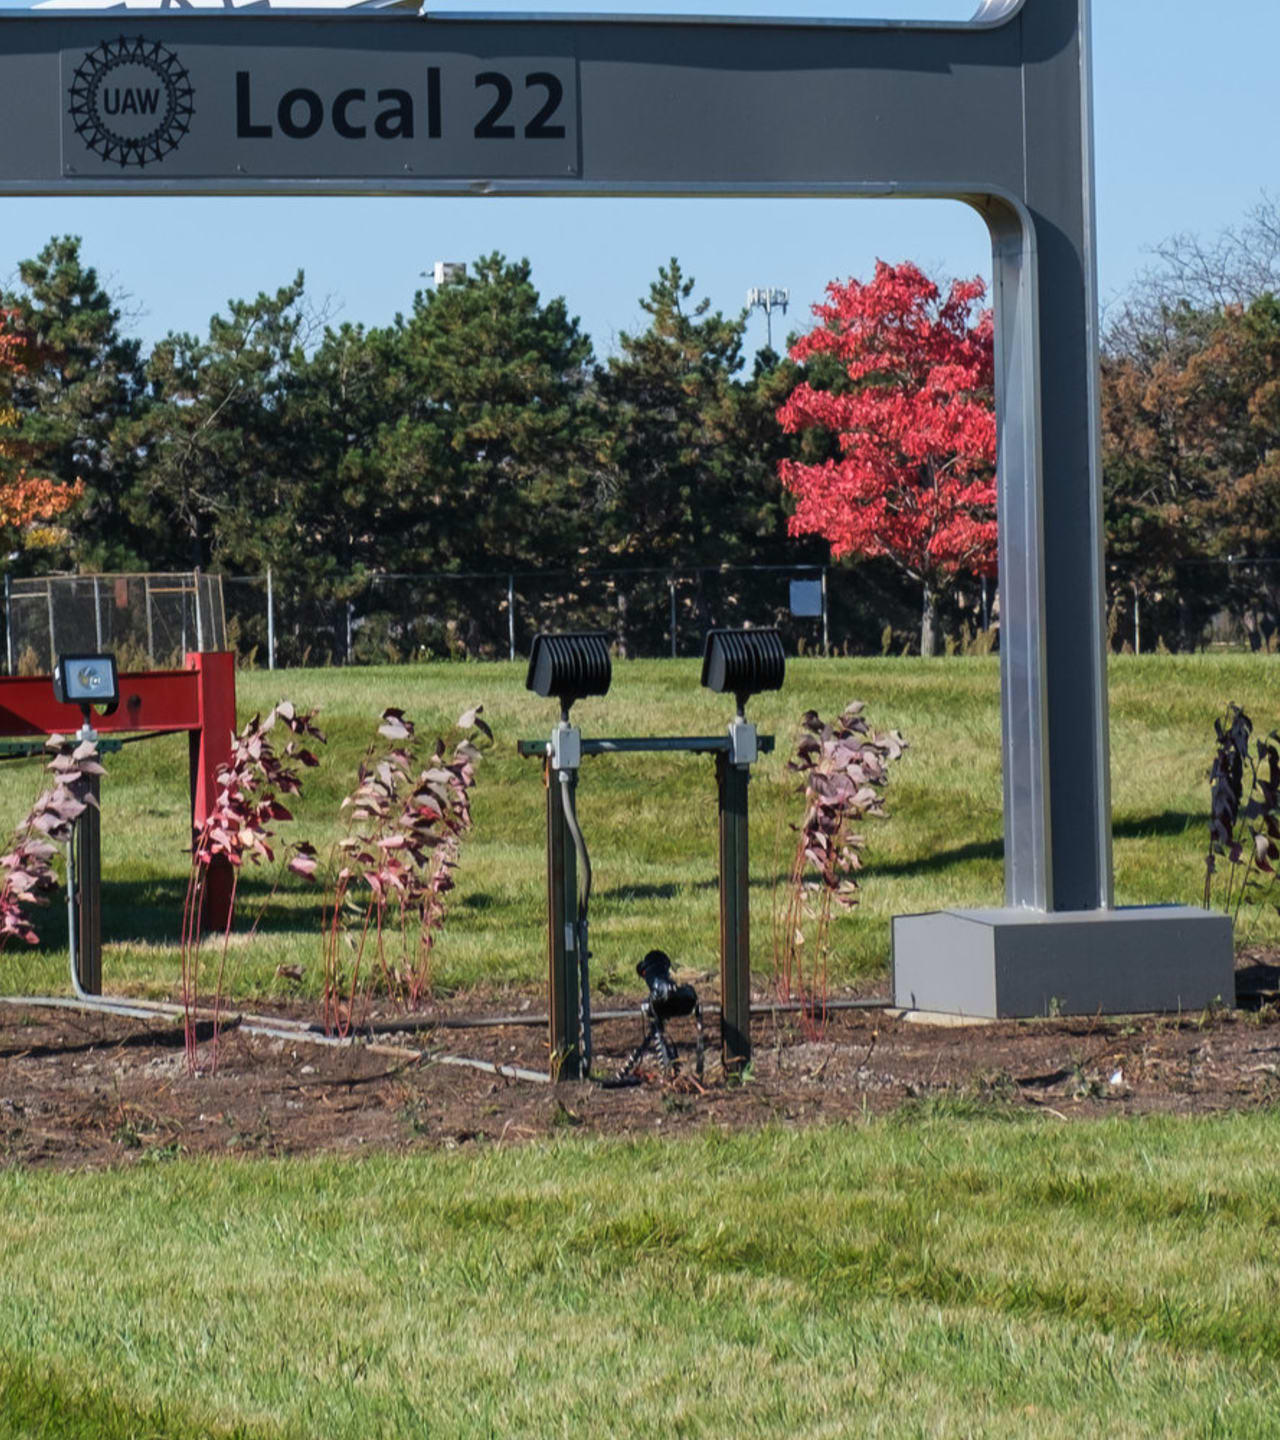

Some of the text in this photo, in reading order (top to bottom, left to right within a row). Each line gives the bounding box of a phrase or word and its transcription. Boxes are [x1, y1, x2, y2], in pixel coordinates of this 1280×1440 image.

[104, 88, 160, 115] UAW
[236, 67, 566, 139] Local 22
